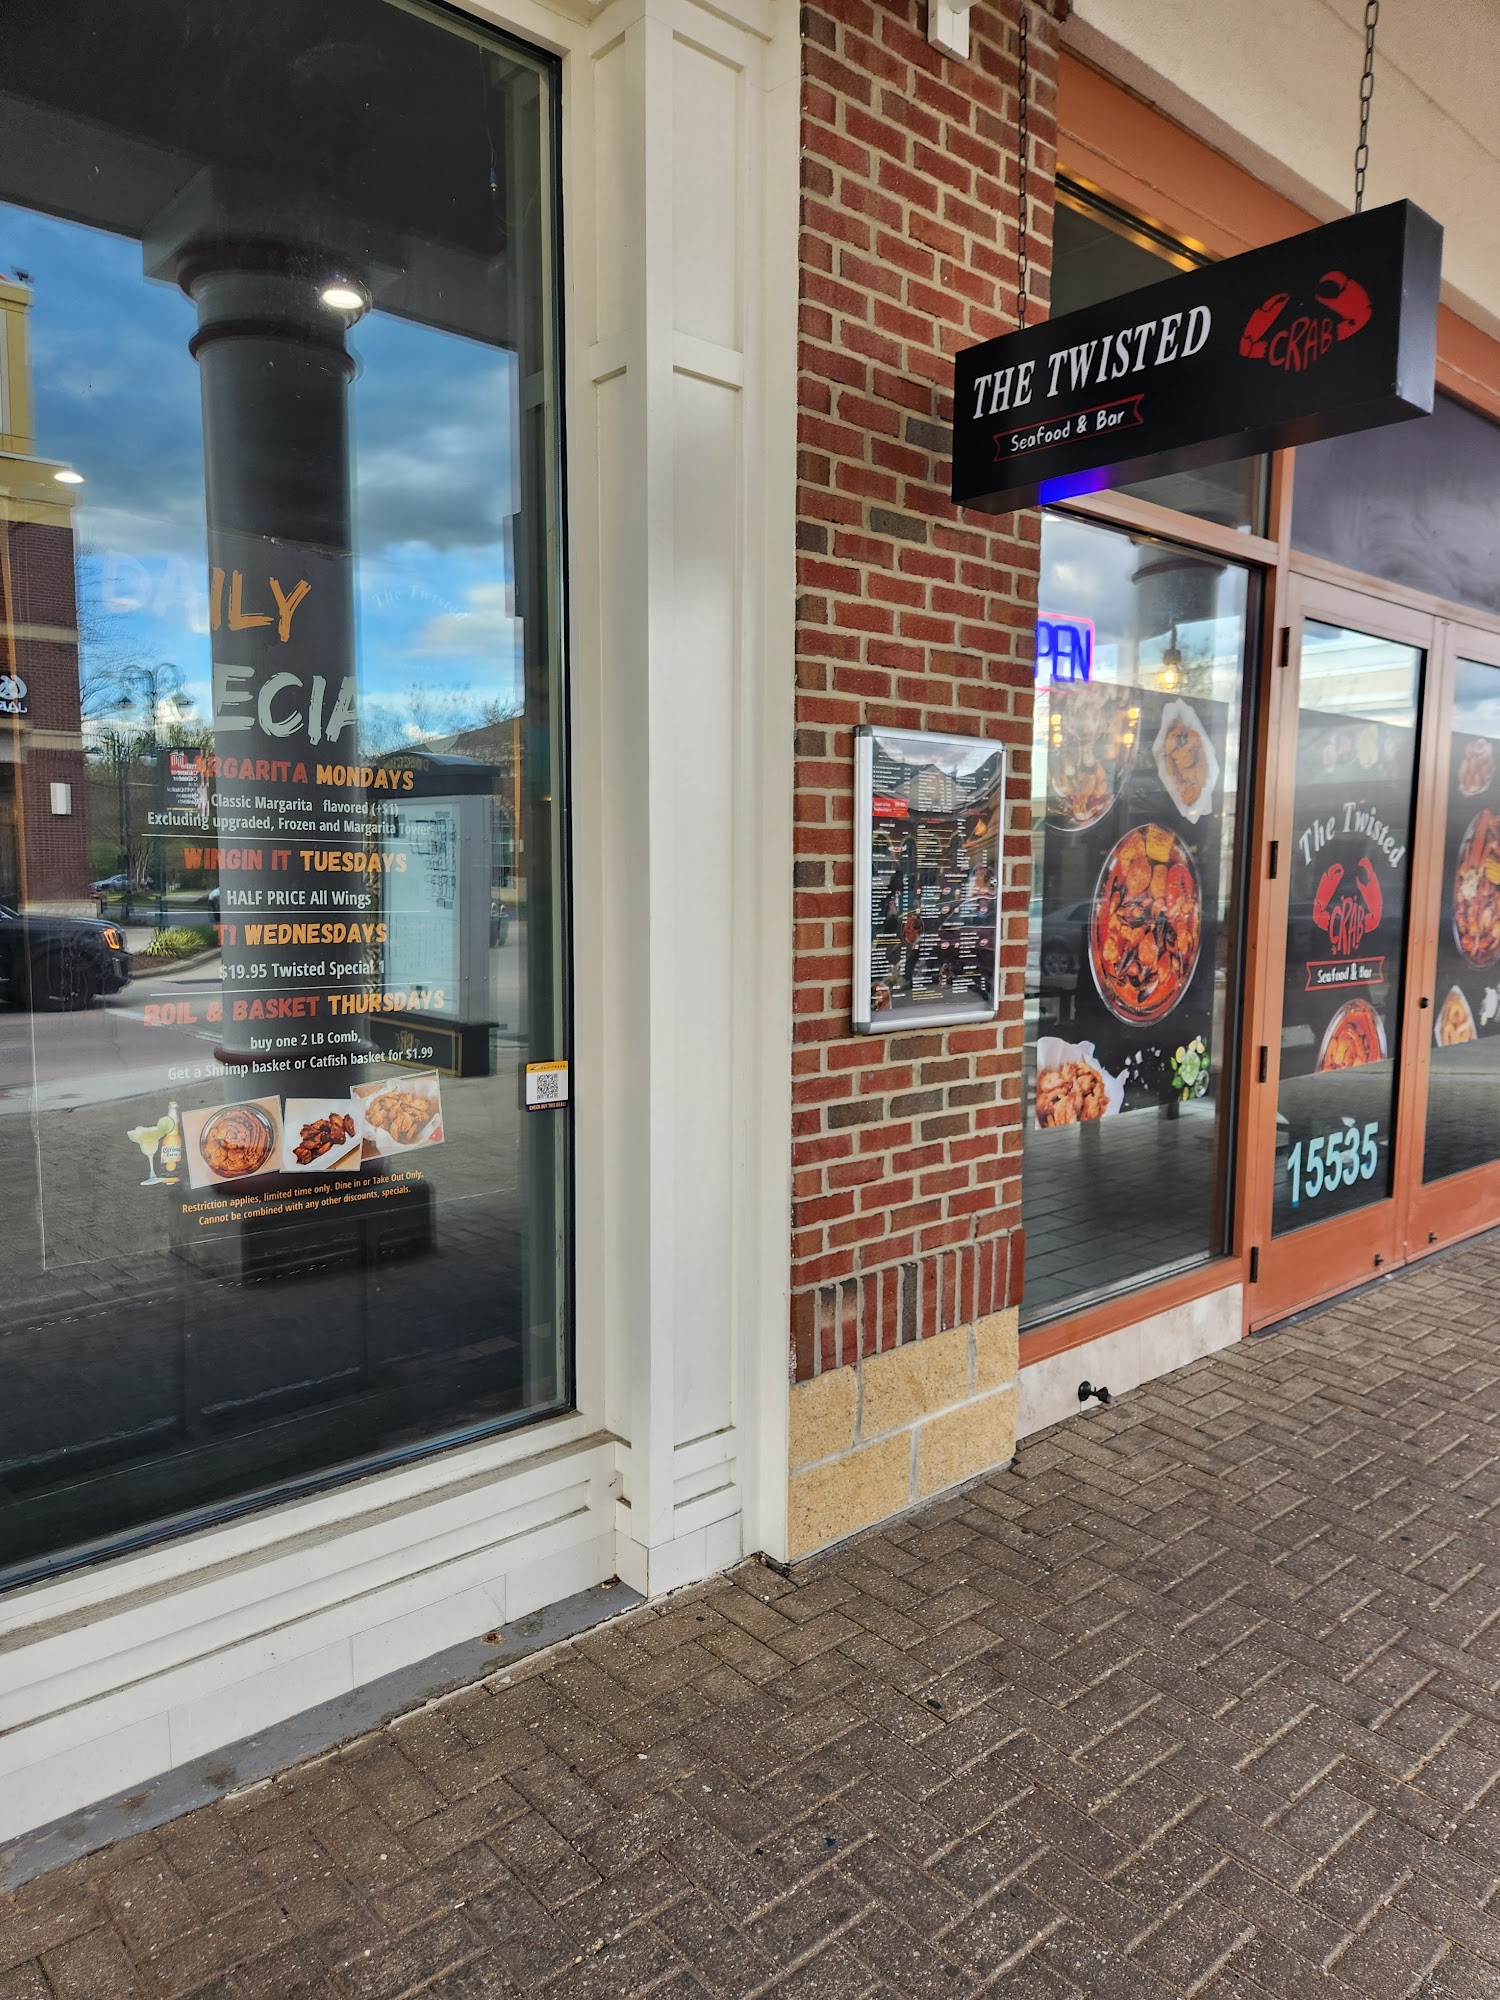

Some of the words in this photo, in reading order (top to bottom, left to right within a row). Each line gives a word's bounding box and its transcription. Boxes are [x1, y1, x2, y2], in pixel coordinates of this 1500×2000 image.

[973, 360, 1036, 419] THE
[1047, 305, 1212, 398] TWISTED
[1268, 316, 1333, 372] CRAB
[1010, 421, 1070, 452] Seafood
[1076, 415, 1088, 433] &
[1096, 410, 1125, 431] Bar
[1034, 621, 1091, 684] PEN
[213, 662, 358, 746] ECIA
[316, 763, 414, 791] MONDAYS
[211, 794, 251, 809] Classic
[254, 796, 313, 814] Margarita
[323, 799, 369, 814] flavored
[147, 811, 210, 830] Excluding
[213, 815, 275, 831] upgraded,
[278, 817, 316, 831] Frozen
[320, 820, 340, 832] and
[343, 820, 396, 837] Margarita
[1299, 815, 1336, 868] The
[1342, 801, 1406, 869] Twisted
[183, 847, 263, 871] WINGIN
[271, 849, 292, 871] IT
[300, 850, 407, 873] TUESDAYS
[227, 890, 263, 905] HALF
[267, 890, 306, 905] PRICE
[310, 889, 328, 905] All
[331, 890, 372, 909] Wings
[244, 922, 388, 946] WEDNESDAYS
[1329, 897, 1365, 955] CRAB
[219, 962, 268, 981] $19.95
[271, 960, 326, 978] Twisted
[329, 959, 374, 979] Special
[1317, 966, 1350, 984] Seafood
[1350, 963, 1358, 981] &
[1359, 966, 1373, 979] Bar
[143, 1000, 198, 1027] BOIL
[206, 1001, 223, 1022] &
[232, 996, 320, 1021] BASKET
[327, 990, 446, 1016] THURSDAYS
[250, 1036, 273, 1051] buy
[276, 1036, 298, 1048] one
[300, 1033, 308, 1046] 2
[311, 1032, 325, 1045] LB
[327, 1029, 362, 1044] Comb,
[168, 1067, 190, 1080] Get
[193, 1068, 201, 1078] a
[205, 1062, 249, 1077] Shrimp
[252, 1058, 291, 1073] basket
[294, 1058, 307, 1070] or
[309, 1053, 348, 1069] Catfish
[350, 1050, 386, 1065] basket
[388, 1049, 404, 1061] for
[406, 1046, 434, 1060] $1.99
[1287, 1121, 1379, 1208] 15535
[182, 1199, 228, 1213] Restriction
[229, 1194, 261, 1208] applies,
[263, 1188, 292, 1202] limited
[294, 1186, 313, 1197] time
[313, 1183, 333, 1194] only.
[335, 1180, 352, 1190] Dine
[353, 1178, 361, 1187] in
[363, 1178, 371, 1186] or
[372, 1175, 389, 1185] Take
[391, 1172, 404, 1181] Out
[405, 1170, 424, 1180] Only.
[199, 1213, 229, 1225] Cannot
[230, 1211, 242, 1221] be
[243, 1204, 283, 1218] combined
[285, 1202, 303, 1212] with
[305, 1199, 320, 1210] any
[321, 1196, 342, 1206] other
[343, 1190, 380, 1203] discounts,
[381, 1185, 411, 1198] specials.
